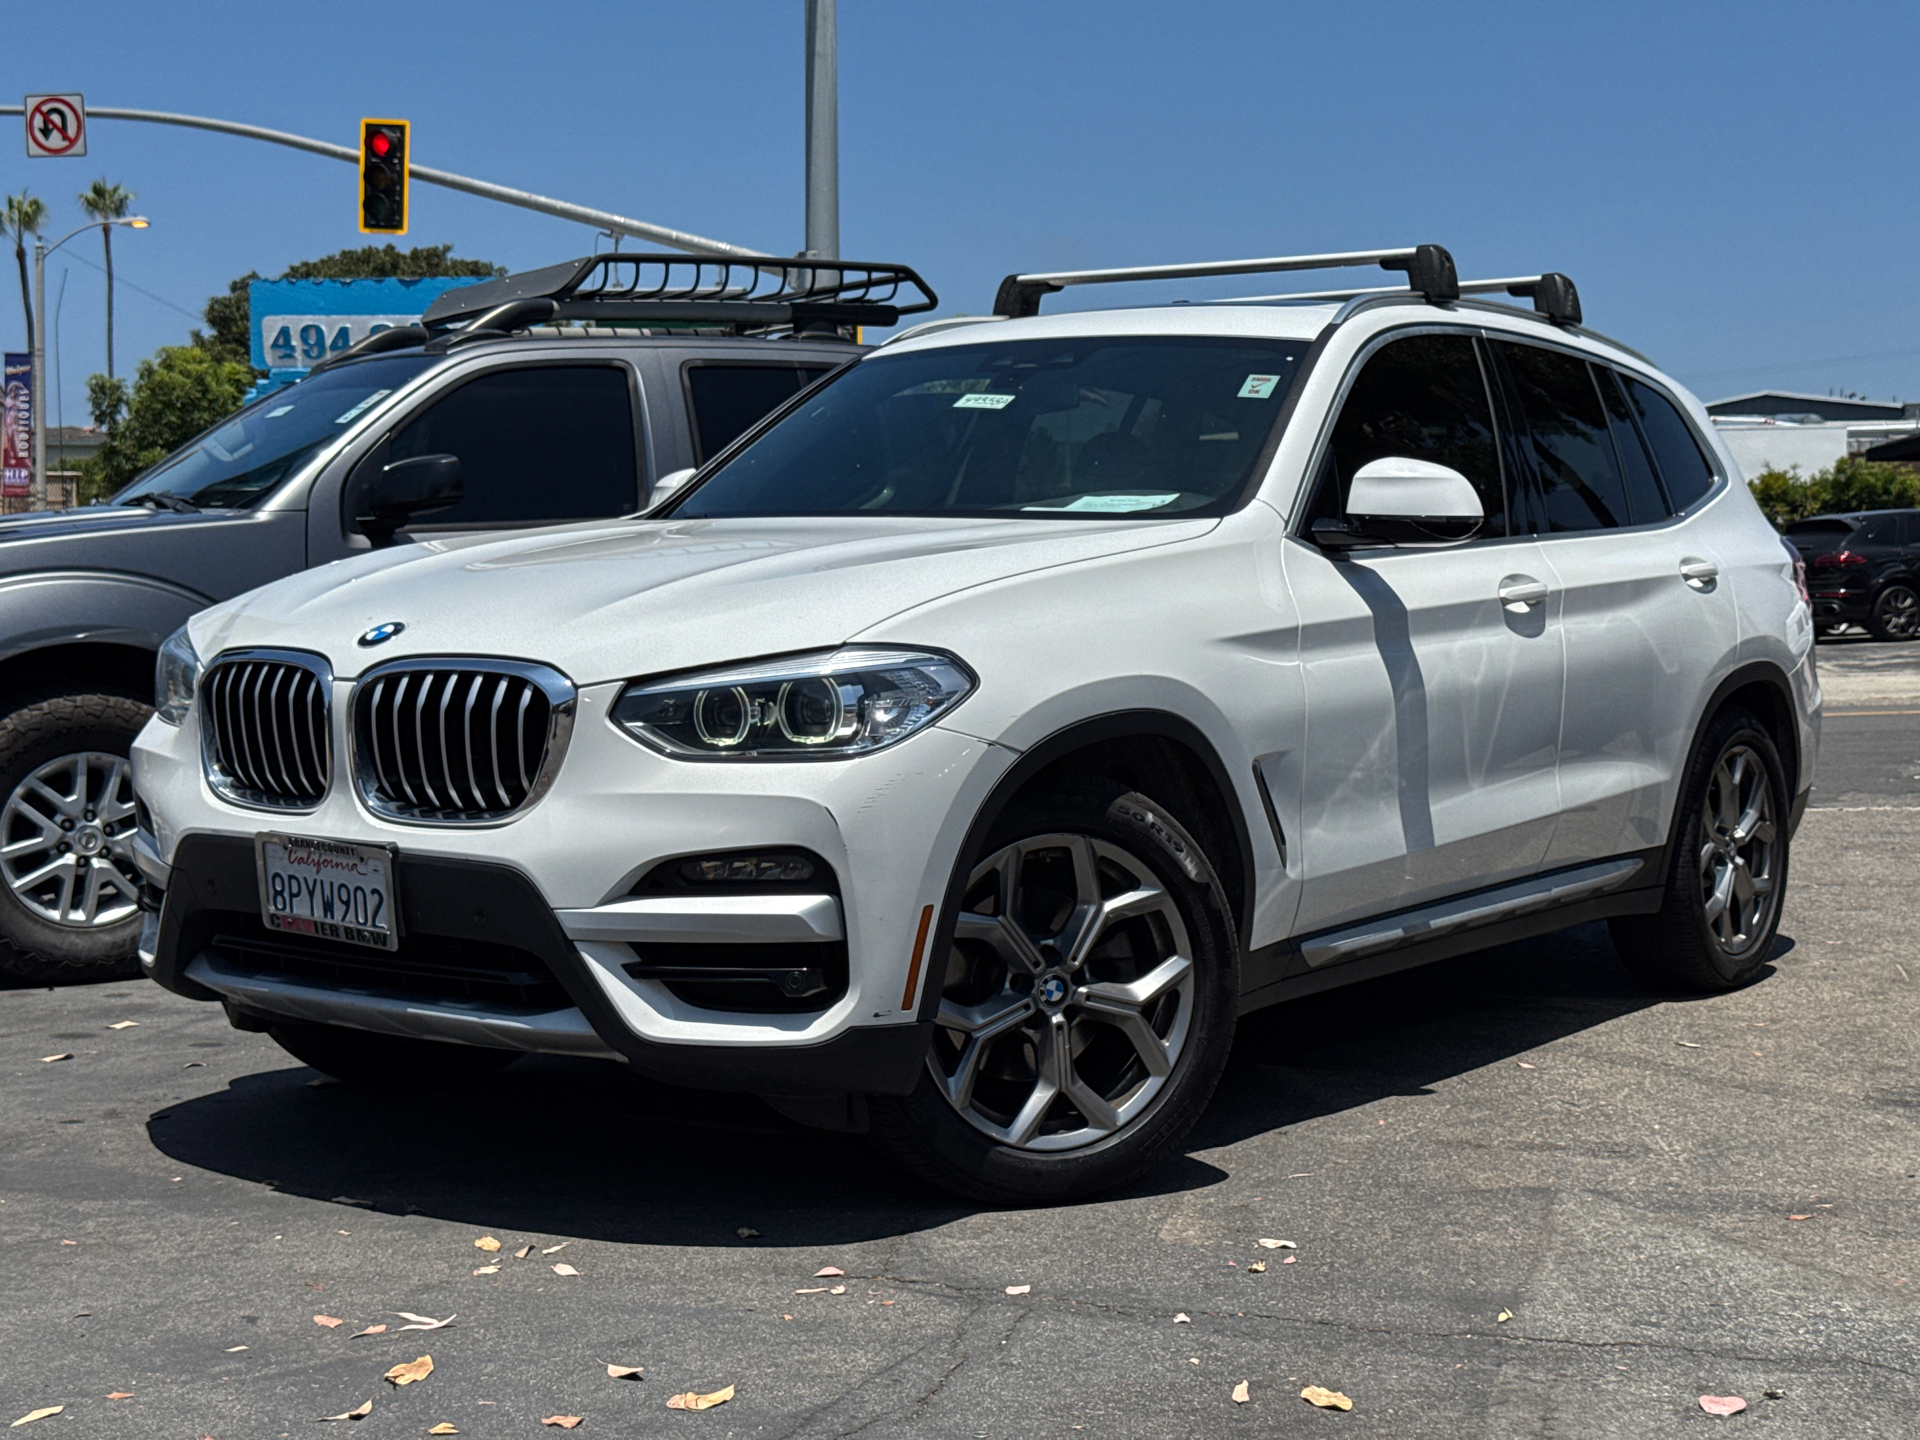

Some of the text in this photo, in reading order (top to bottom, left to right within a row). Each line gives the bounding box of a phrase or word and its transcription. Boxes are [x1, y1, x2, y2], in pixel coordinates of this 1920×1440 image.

[4, 468, 29, 479] HIP
[1117, 805, 1146, 823] 50
[321, 842, 355, 857] COUNTY
[288, 848, 368, 875] California
[271, 872, 388, 930] 8PYW902
[344, 925, 388, 947] BMW
